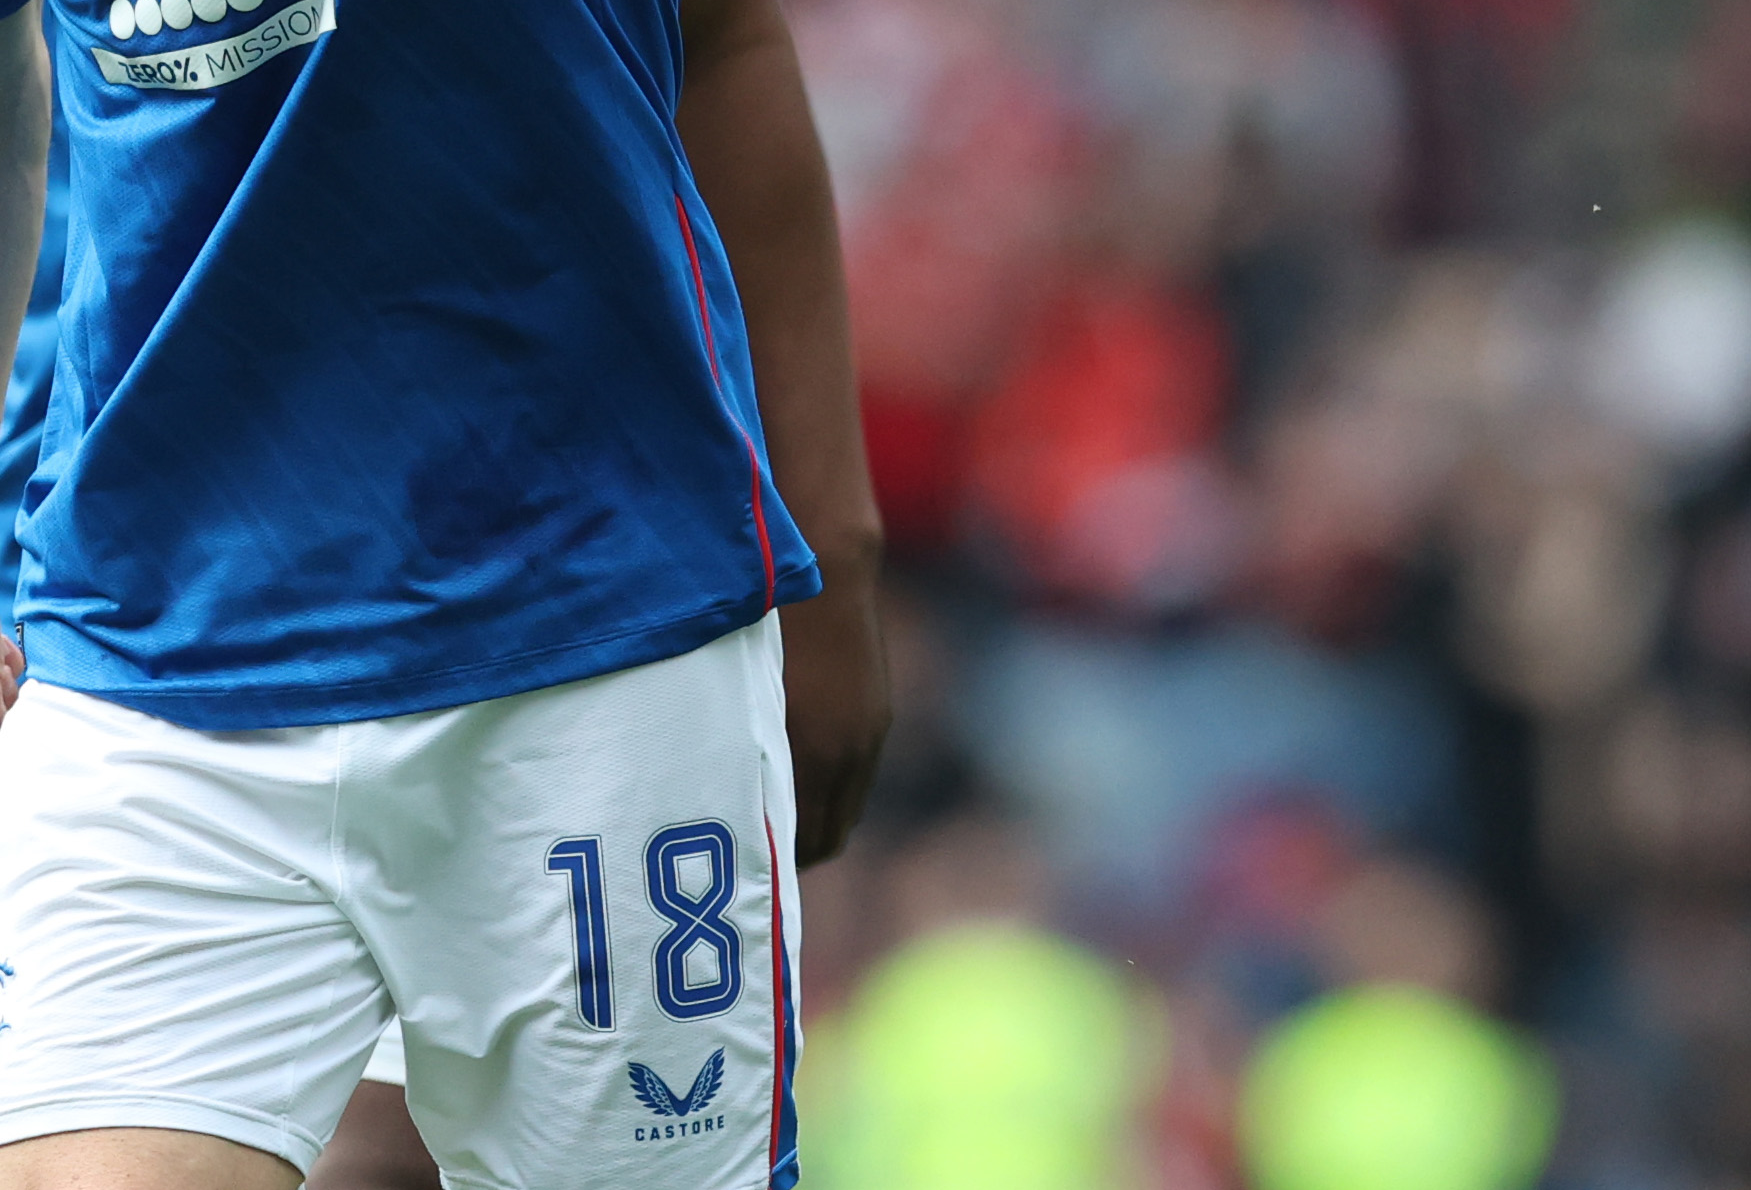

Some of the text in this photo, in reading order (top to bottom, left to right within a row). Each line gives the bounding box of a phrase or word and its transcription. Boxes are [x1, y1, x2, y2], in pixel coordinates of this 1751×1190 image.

[118, 57, 198, 83] ZERO%
[545, 818, 744, 1032] 18
[635, 1115, 725, 1141] CASTORE
